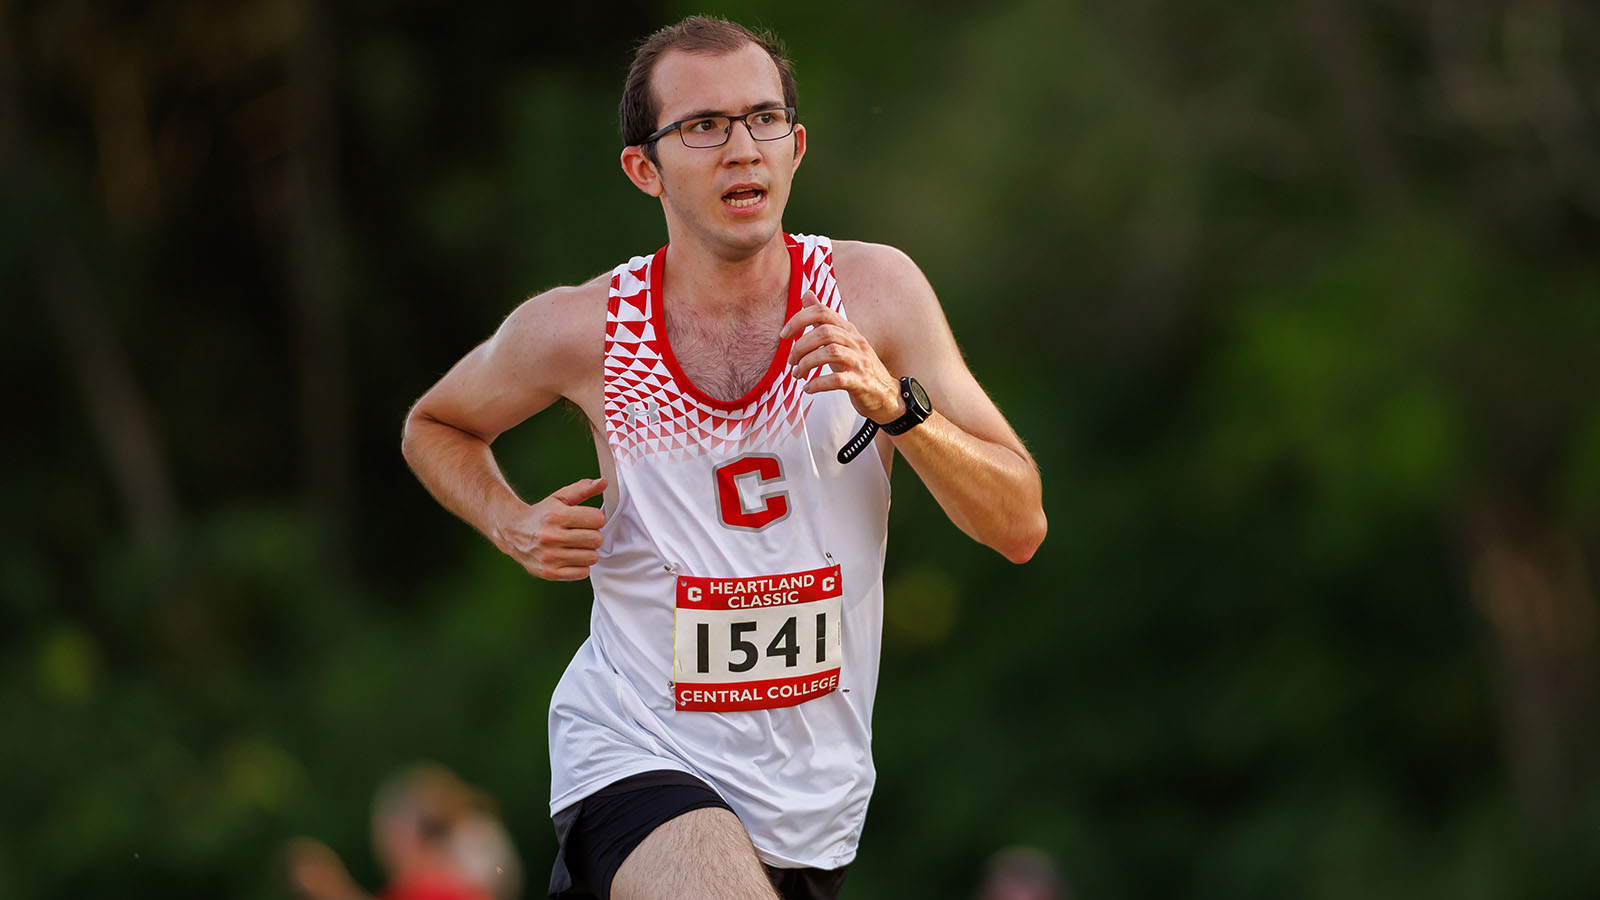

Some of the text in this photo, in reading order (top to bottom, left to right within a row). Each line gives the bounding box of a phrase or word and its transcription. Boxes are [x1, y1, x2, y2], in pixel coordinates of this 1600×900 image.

[712, 452, 792, 533] C
[687, 586, 702, 602] C
[710, 574, 815, 594] HEARTLAND
[822, 576, 835, 592] C
[727, 591, 799, 608] CLASSIC
[697, 613, 826, 673] 1541
[680, 675, 837, 703] CENTRAL COLLEGE
